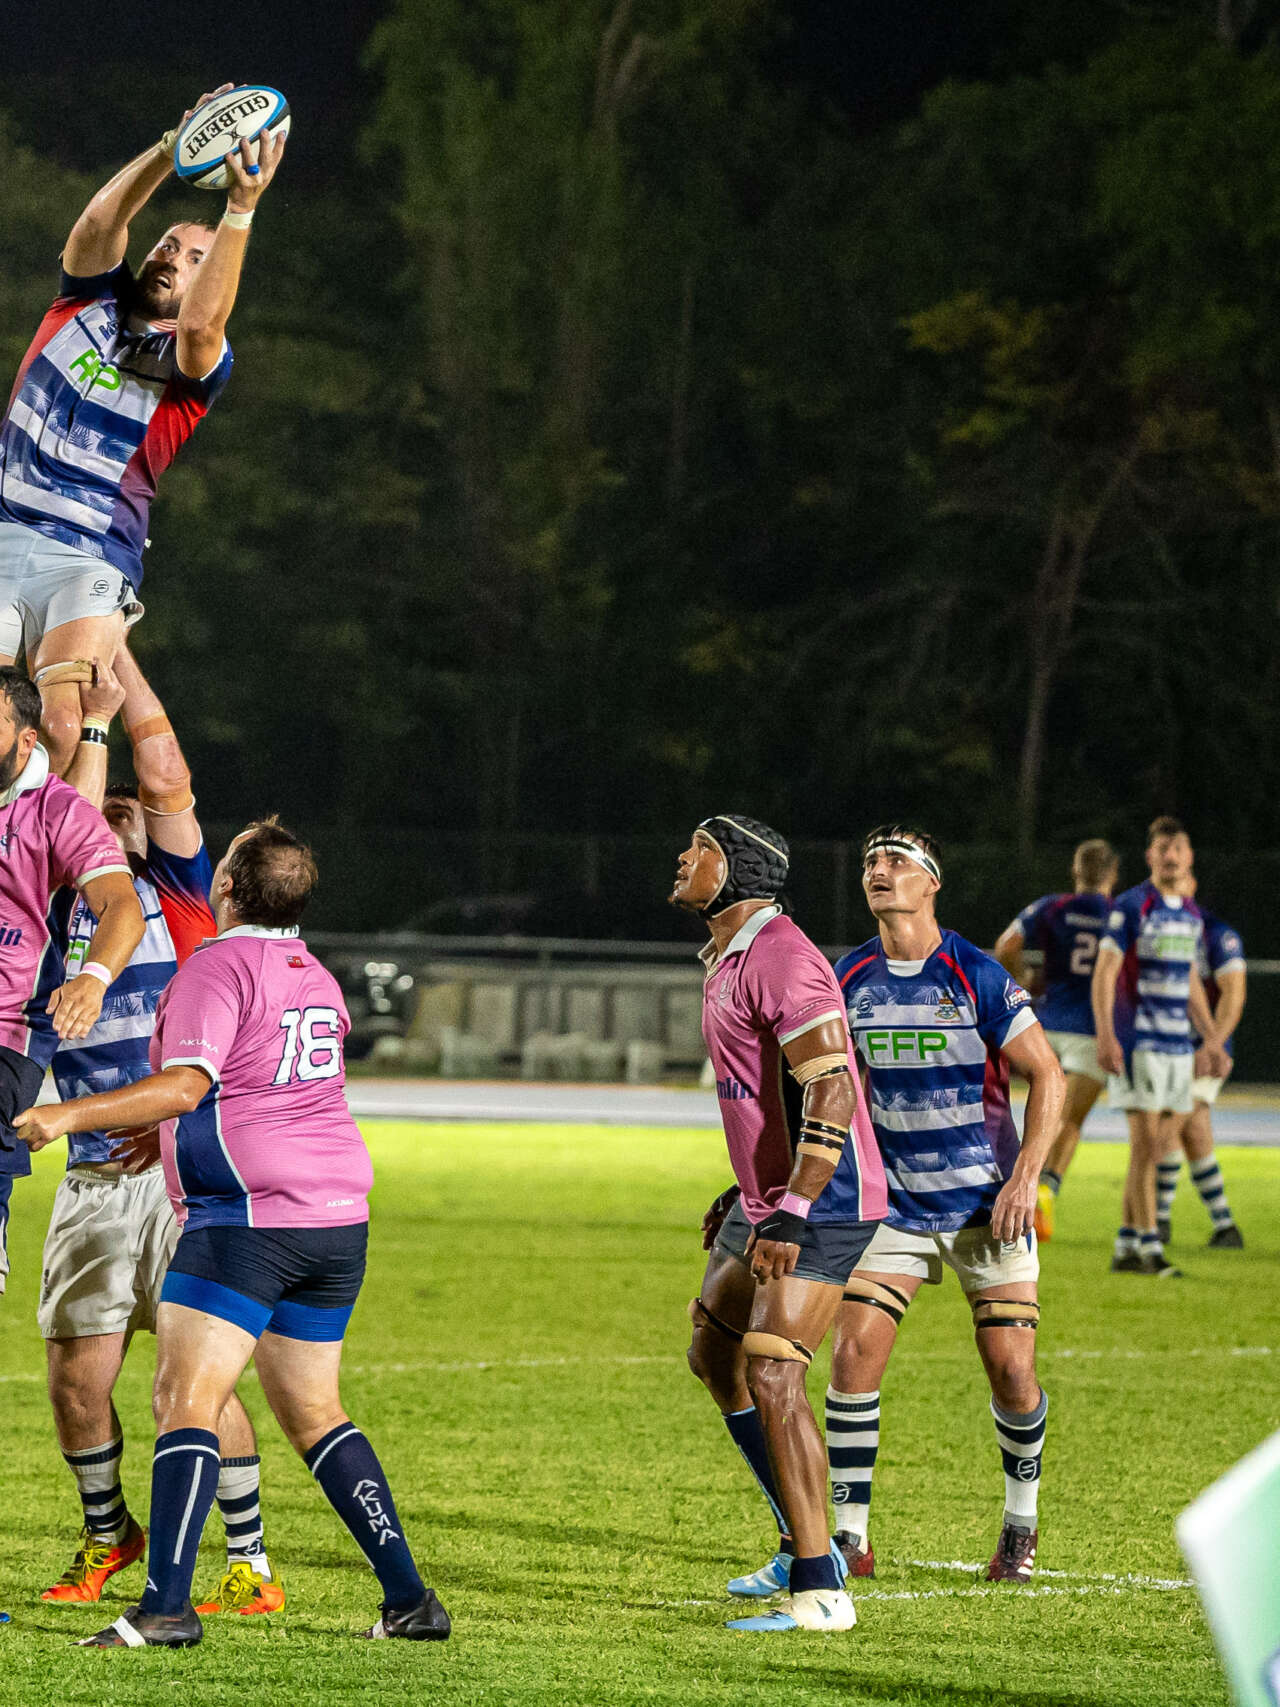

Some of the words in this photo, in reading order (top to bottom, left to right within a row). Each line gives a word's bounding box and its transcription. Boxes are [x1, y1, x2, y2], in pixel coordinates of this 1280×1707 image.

[185, 95, 269, 160] GILBERT
[179, 1038, 219, 1054] AKUMA
[271, 1006, 345, 1086] 16
[866, 1031, 948, 1061] FFP
[353, 1479, 401, 1546] AKUMA
